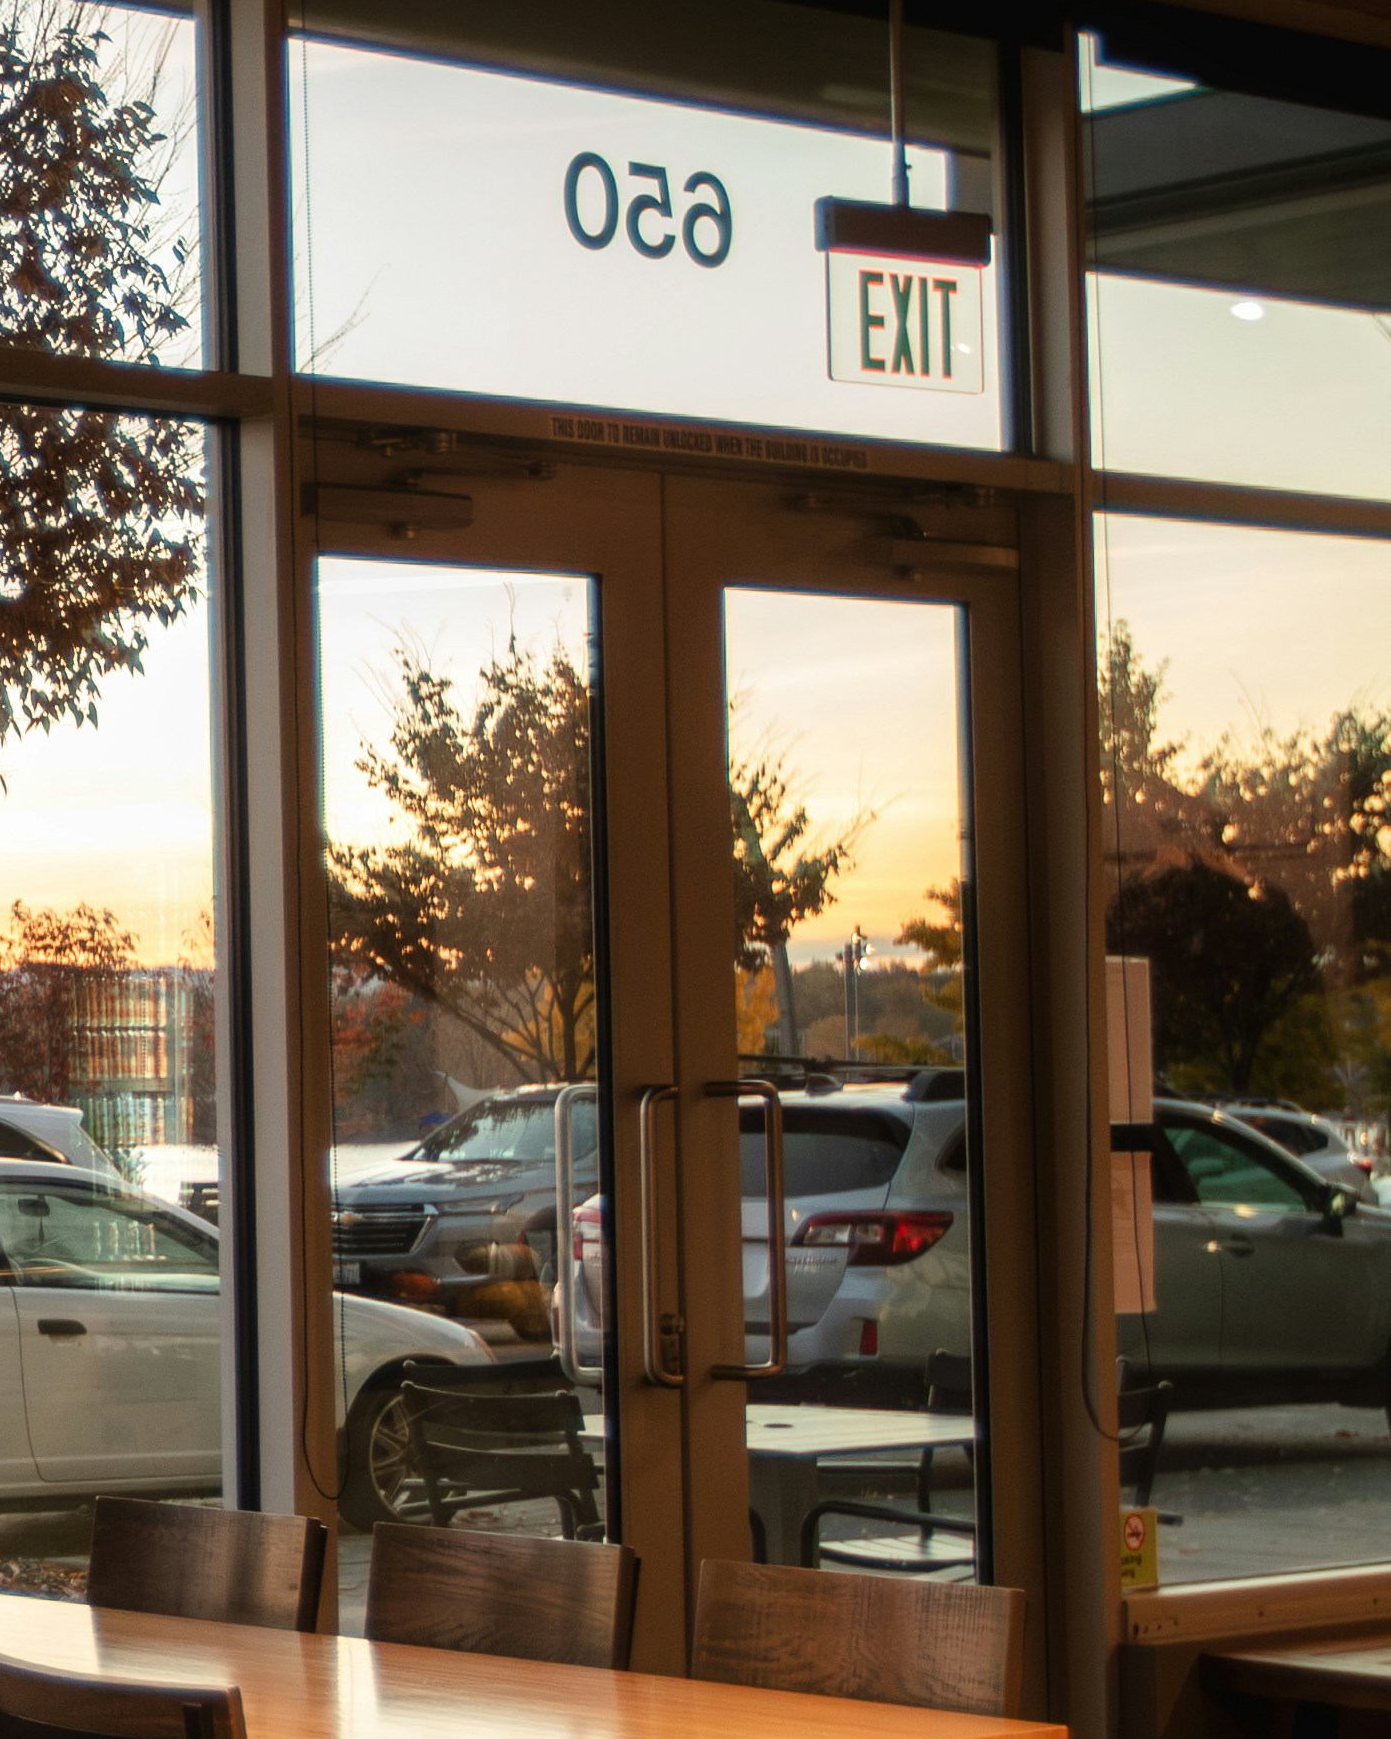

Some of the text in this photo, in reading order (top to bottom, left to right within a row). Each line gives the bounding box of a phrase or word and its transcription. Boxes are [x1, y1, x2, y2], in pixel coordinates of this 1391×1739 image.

[859, 270, 957, 379] EXIT
[552, 418, 574, 438] THIS
[577, 420, 604, 442] DOOR
[608, 423, 619, 444] TO
[623, 425, 660, 448] REMAIN
[663, 429, 712, 453] UNLOCKED
[716, 435, 742, 455] WHEN
[745, 438, 763, 458] THE
[766, 440, 808, 463] BUILDING
